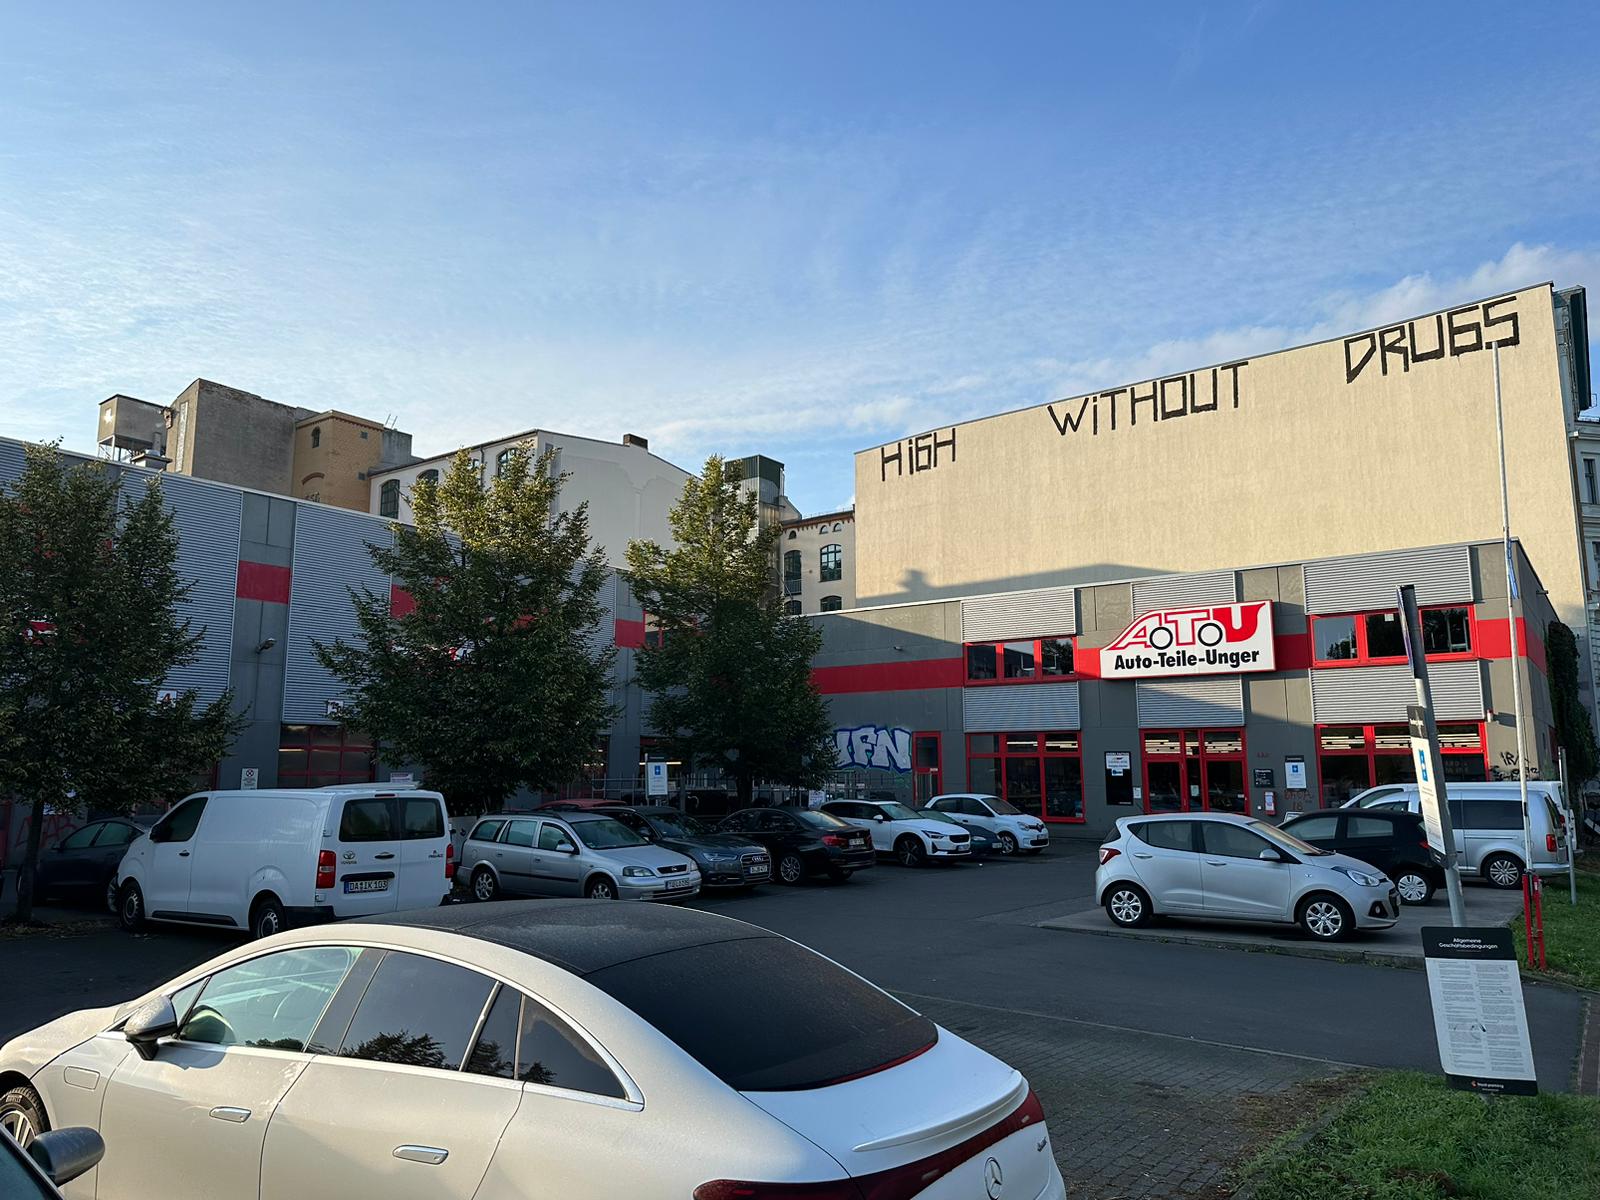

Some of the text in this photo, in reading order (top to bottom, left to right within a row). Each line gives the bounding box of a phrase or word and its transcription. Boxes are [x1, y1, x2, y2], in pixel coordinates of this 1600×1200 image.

[1344, 296, 1520, 384] DRUGS
[1114, 649, 1260, 670] Auto-Teile-Unger
[1438, 942, 1498, 950] Geschäftsbedingungen
